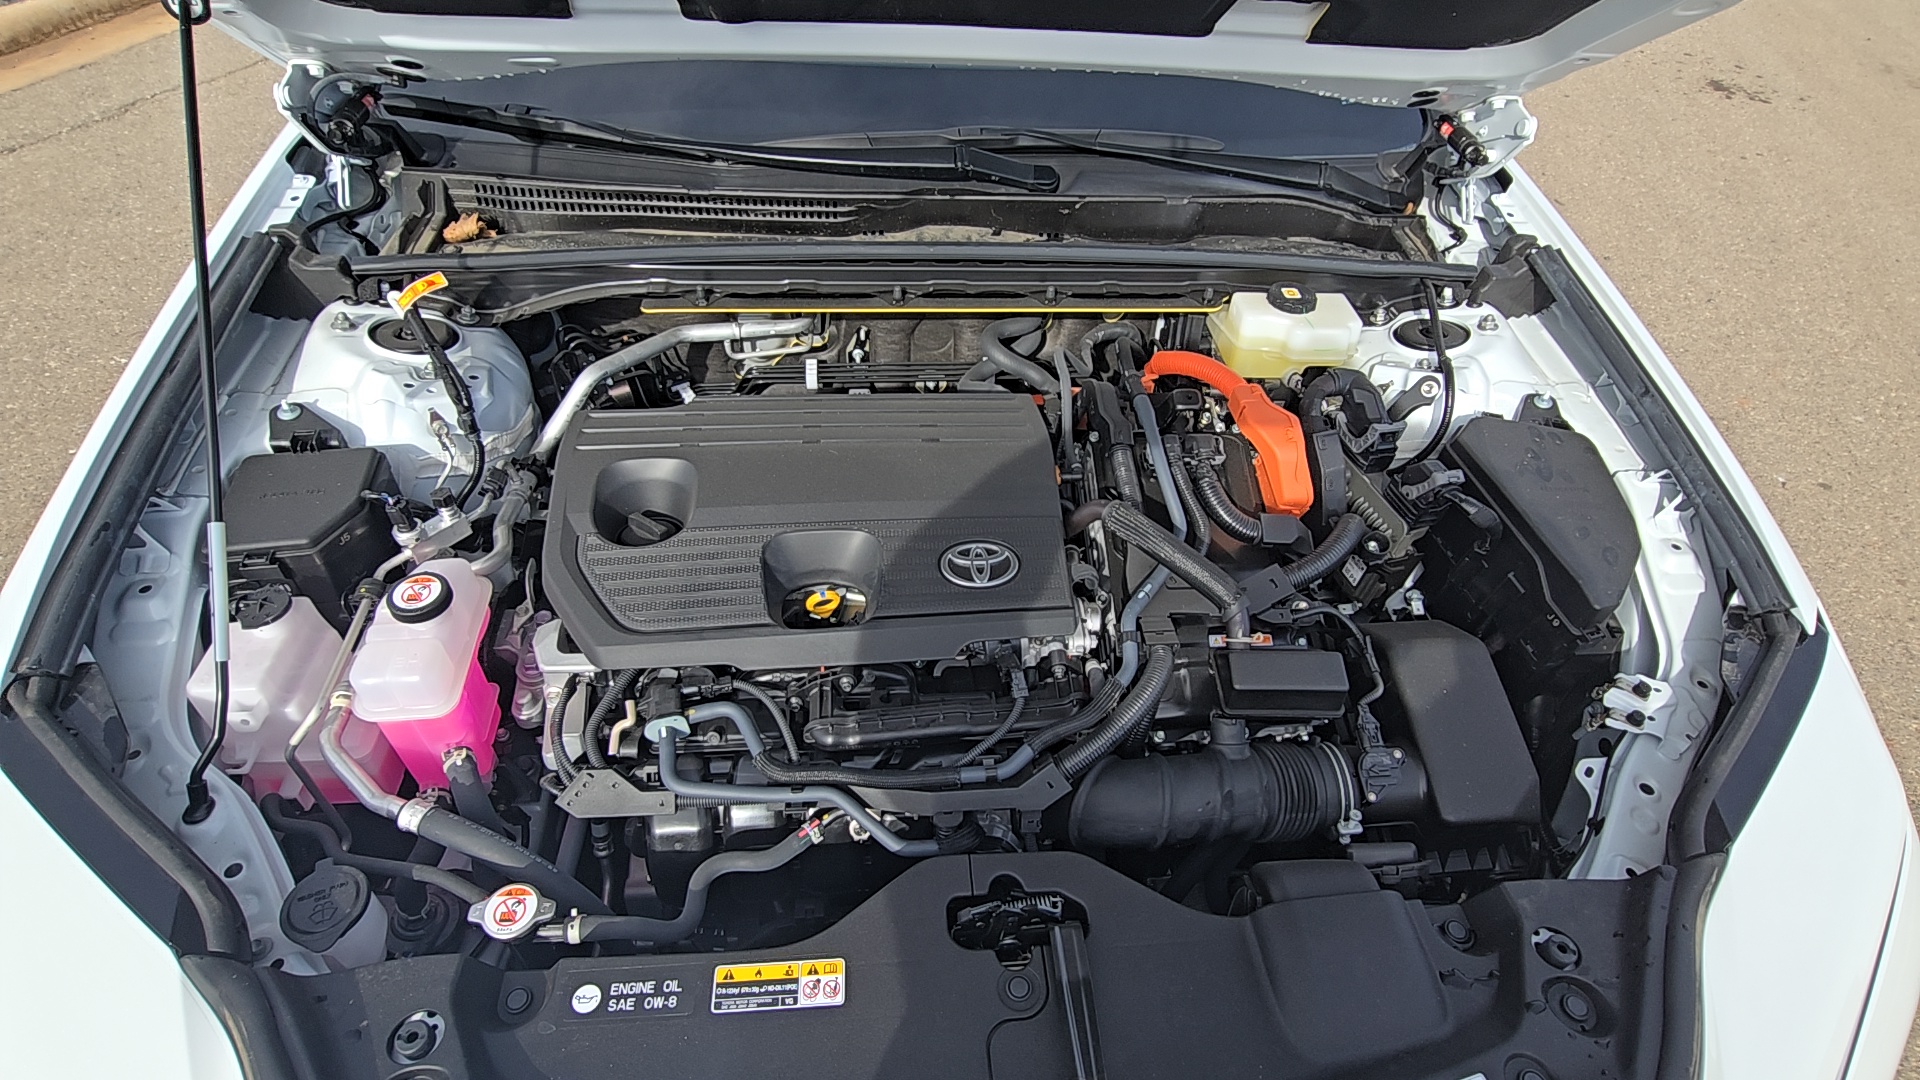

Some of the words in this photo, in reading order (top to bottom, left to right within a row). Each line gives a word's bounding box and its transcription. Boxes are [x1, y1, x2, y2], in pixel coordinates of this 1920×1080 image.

[609, 981, 656, 996] ENGINE
[662, 979, 683, 993] OIL
[607, 998, 636, 1012] SAE
